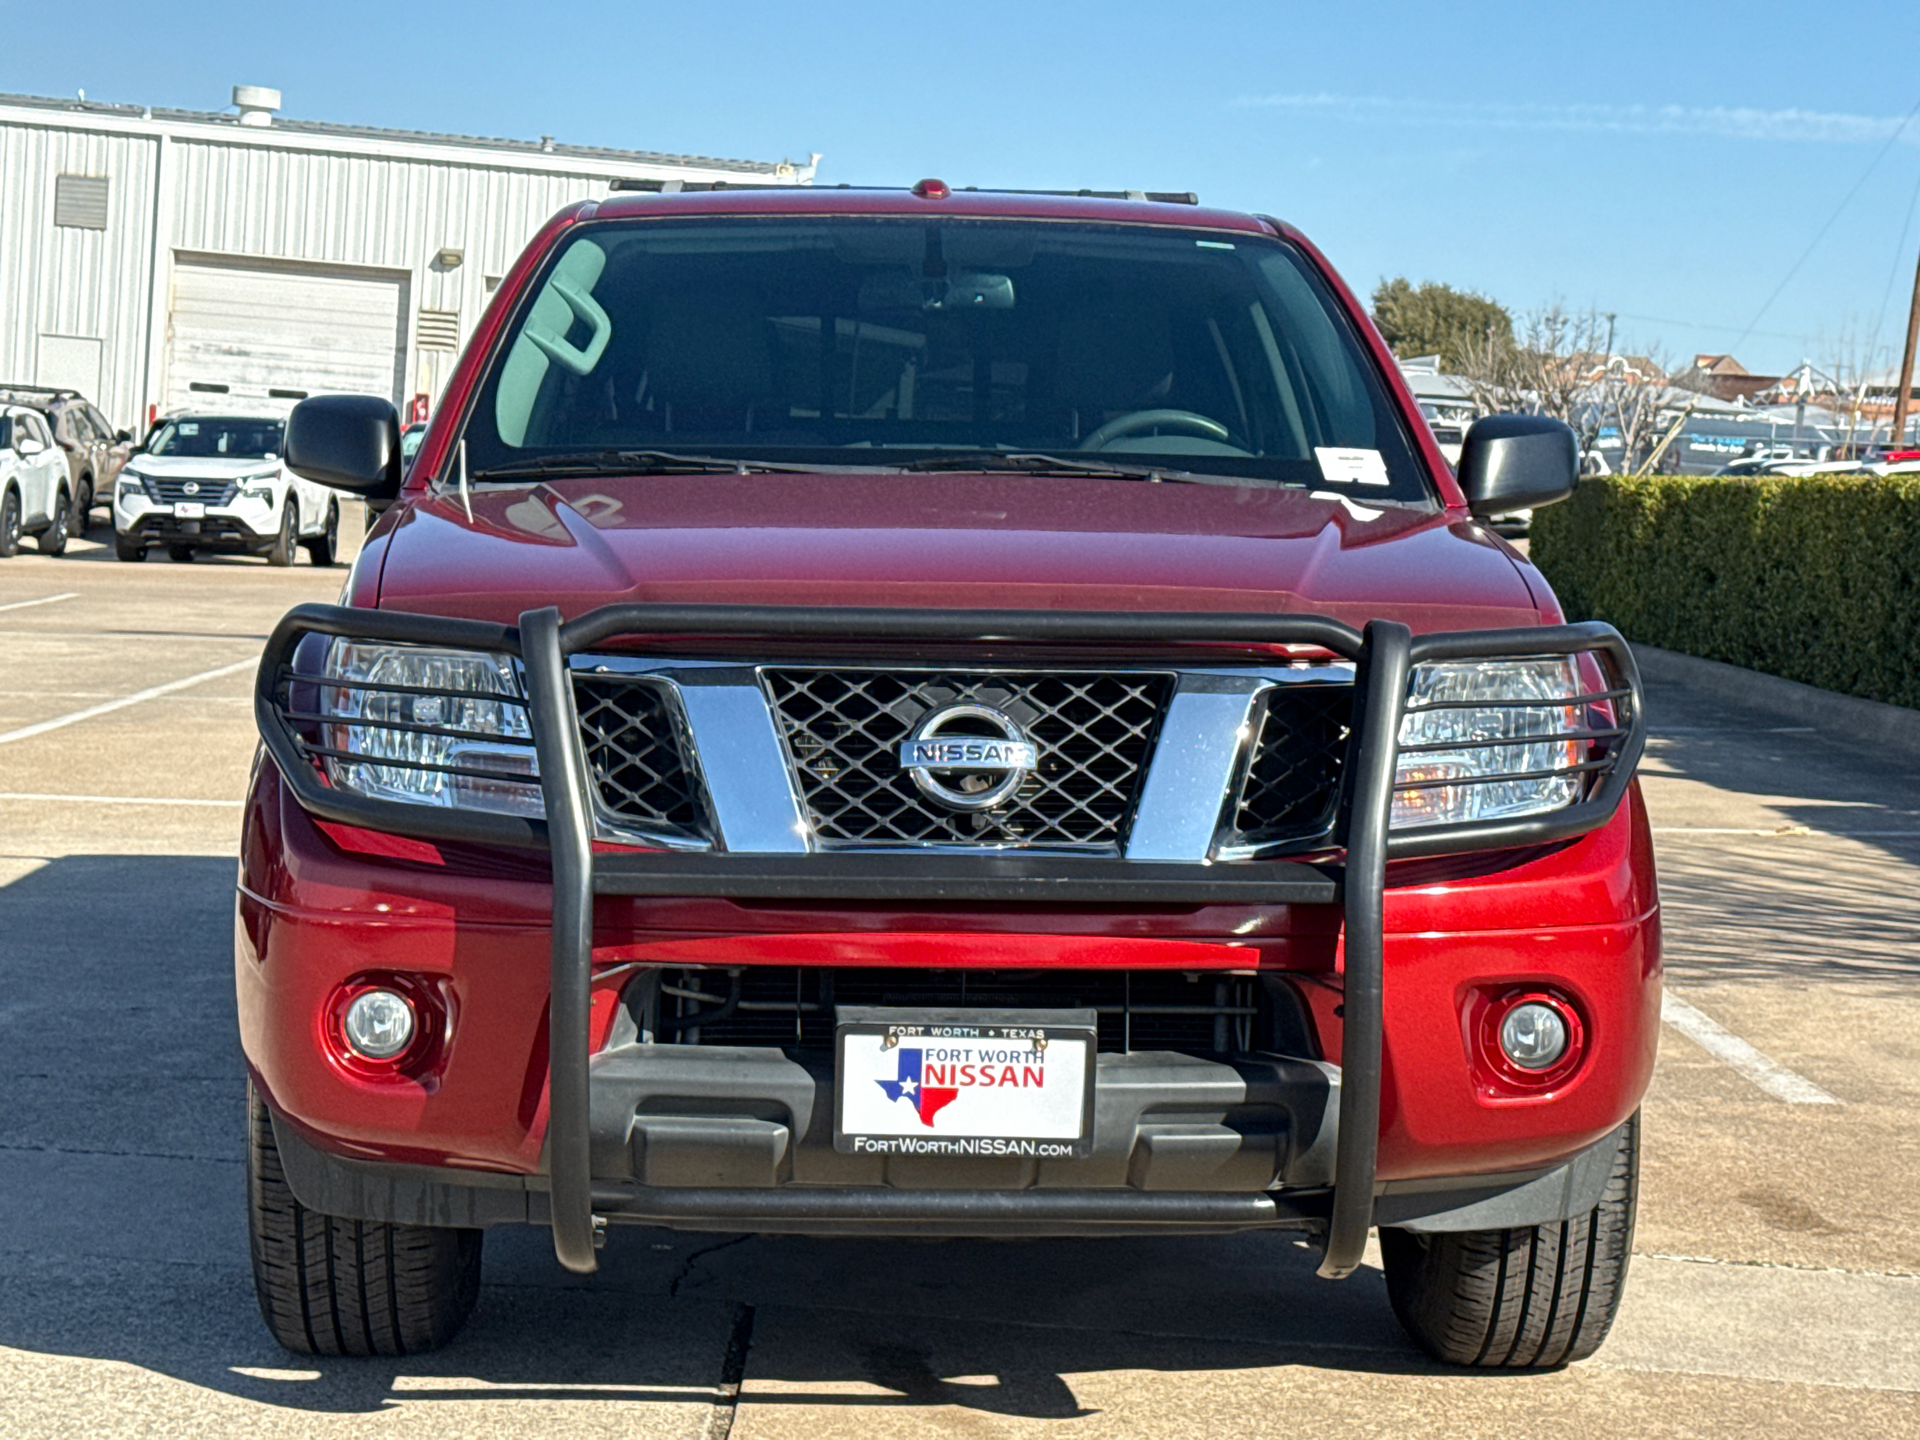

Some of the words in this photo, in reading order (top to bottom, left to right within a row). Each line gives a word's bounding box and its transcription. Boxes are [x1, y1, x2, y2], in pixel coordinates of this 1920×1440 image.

[914, 743, 1026, 763] NISSAN
[888, 1026, 925, 1037] FORT
[930, 1027, 980, 1038] WORTH
[1001, 1029, 1046, 1040] TEXAS
[925, 1048, 973, 1062] FORT
[978, 1049, 1045, 1064] WORTH
[924, 1063, 1045, 1088] NISSAN
